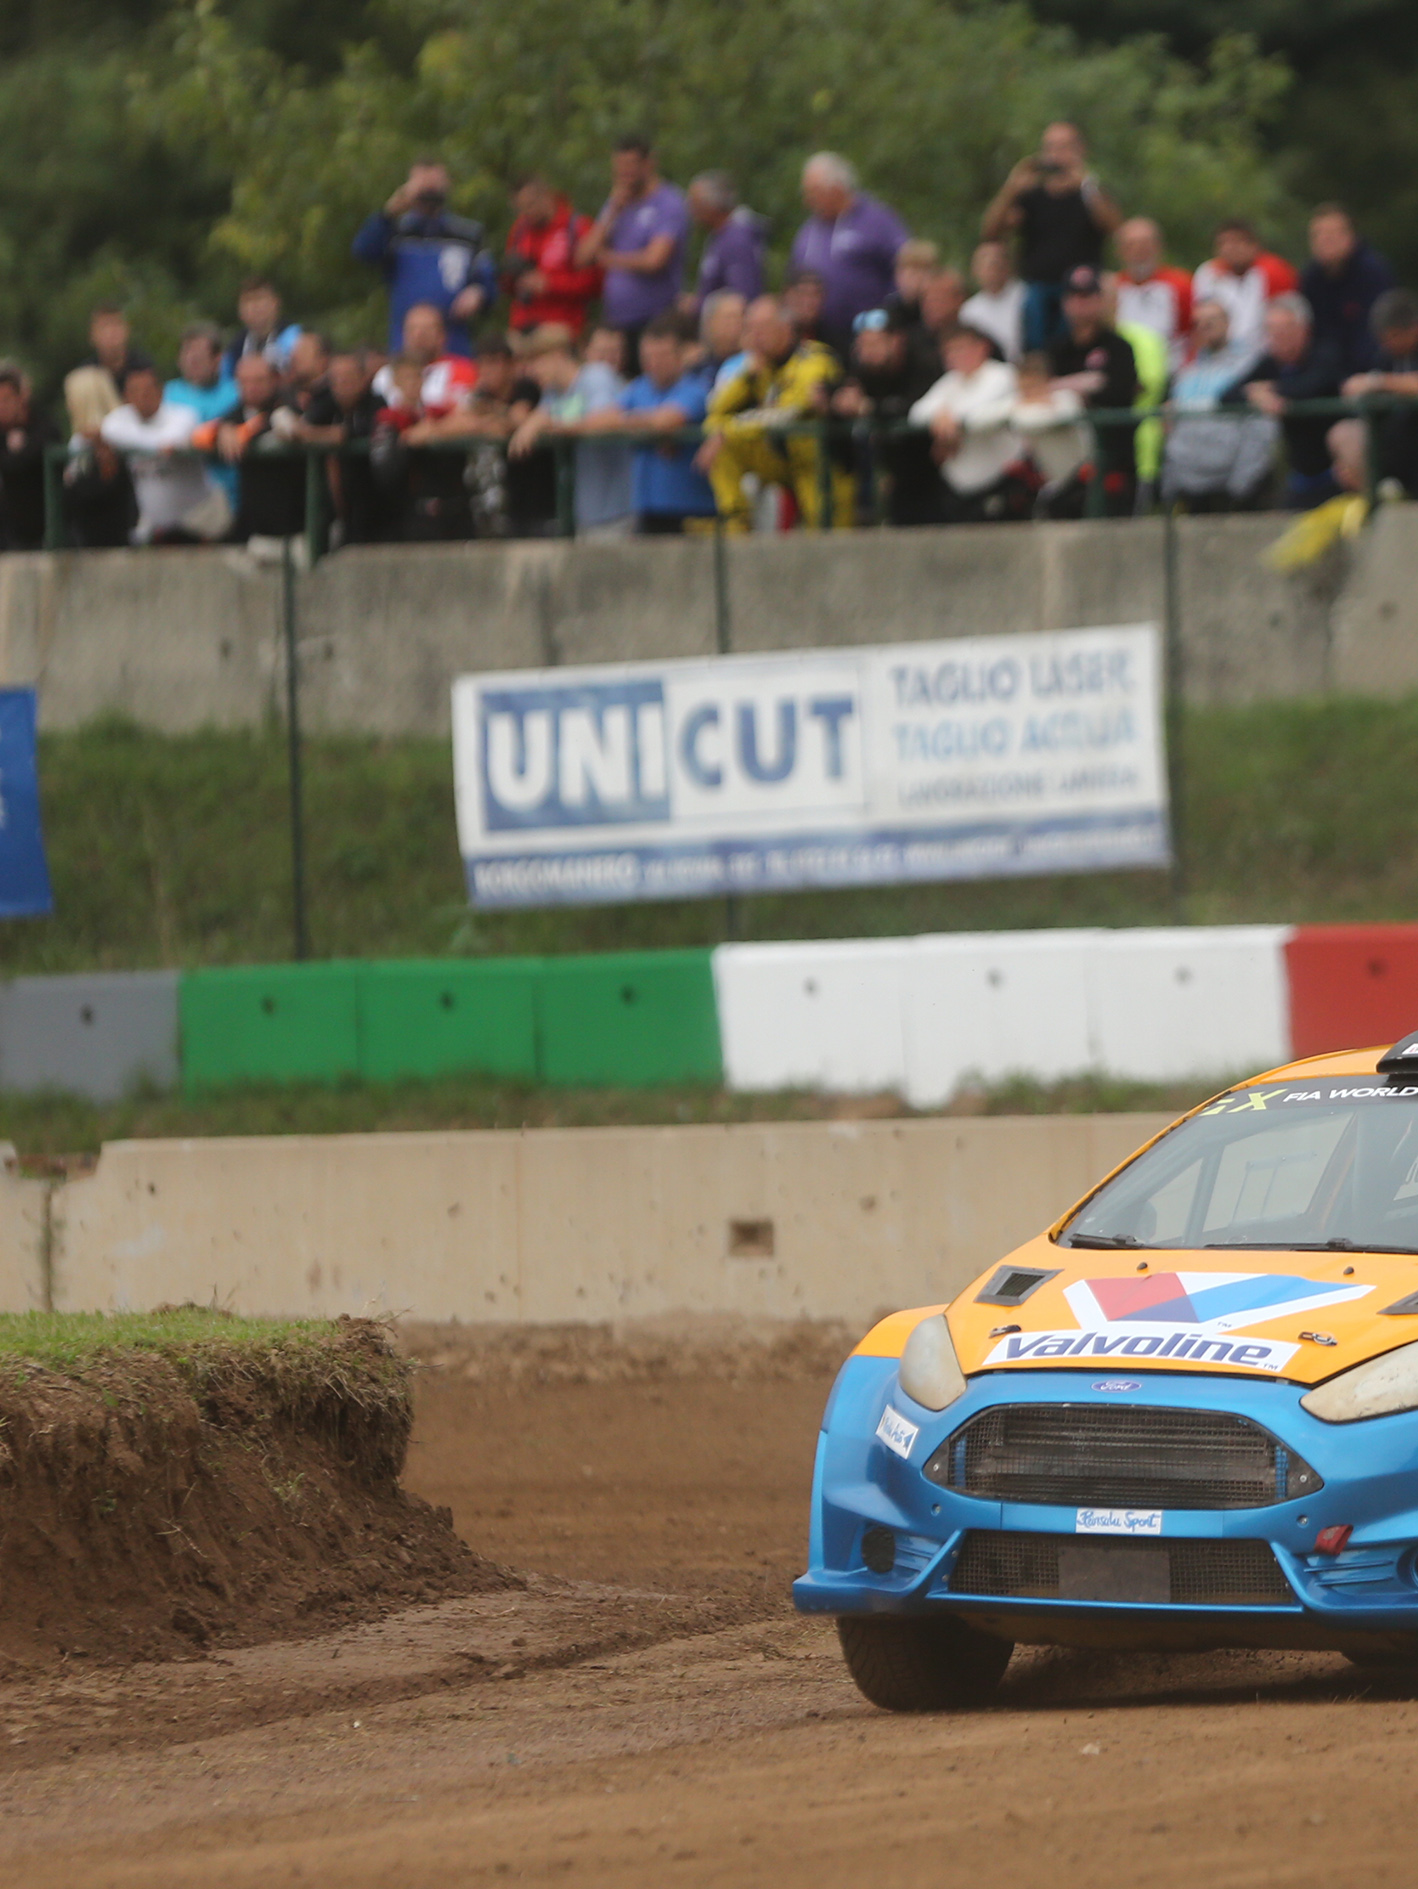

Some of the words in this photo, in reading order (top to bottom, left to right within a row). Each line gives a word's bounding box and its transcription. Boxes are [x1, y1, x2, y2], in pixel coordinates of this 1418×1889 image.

[1282, 1090, 1322, 1103] FIA
[1006, 1331, 1273, 1366] Valvoline
[1100, 1380, 1132, 1391] Ford
[1123, 1511, 1161, 1532] Sport
